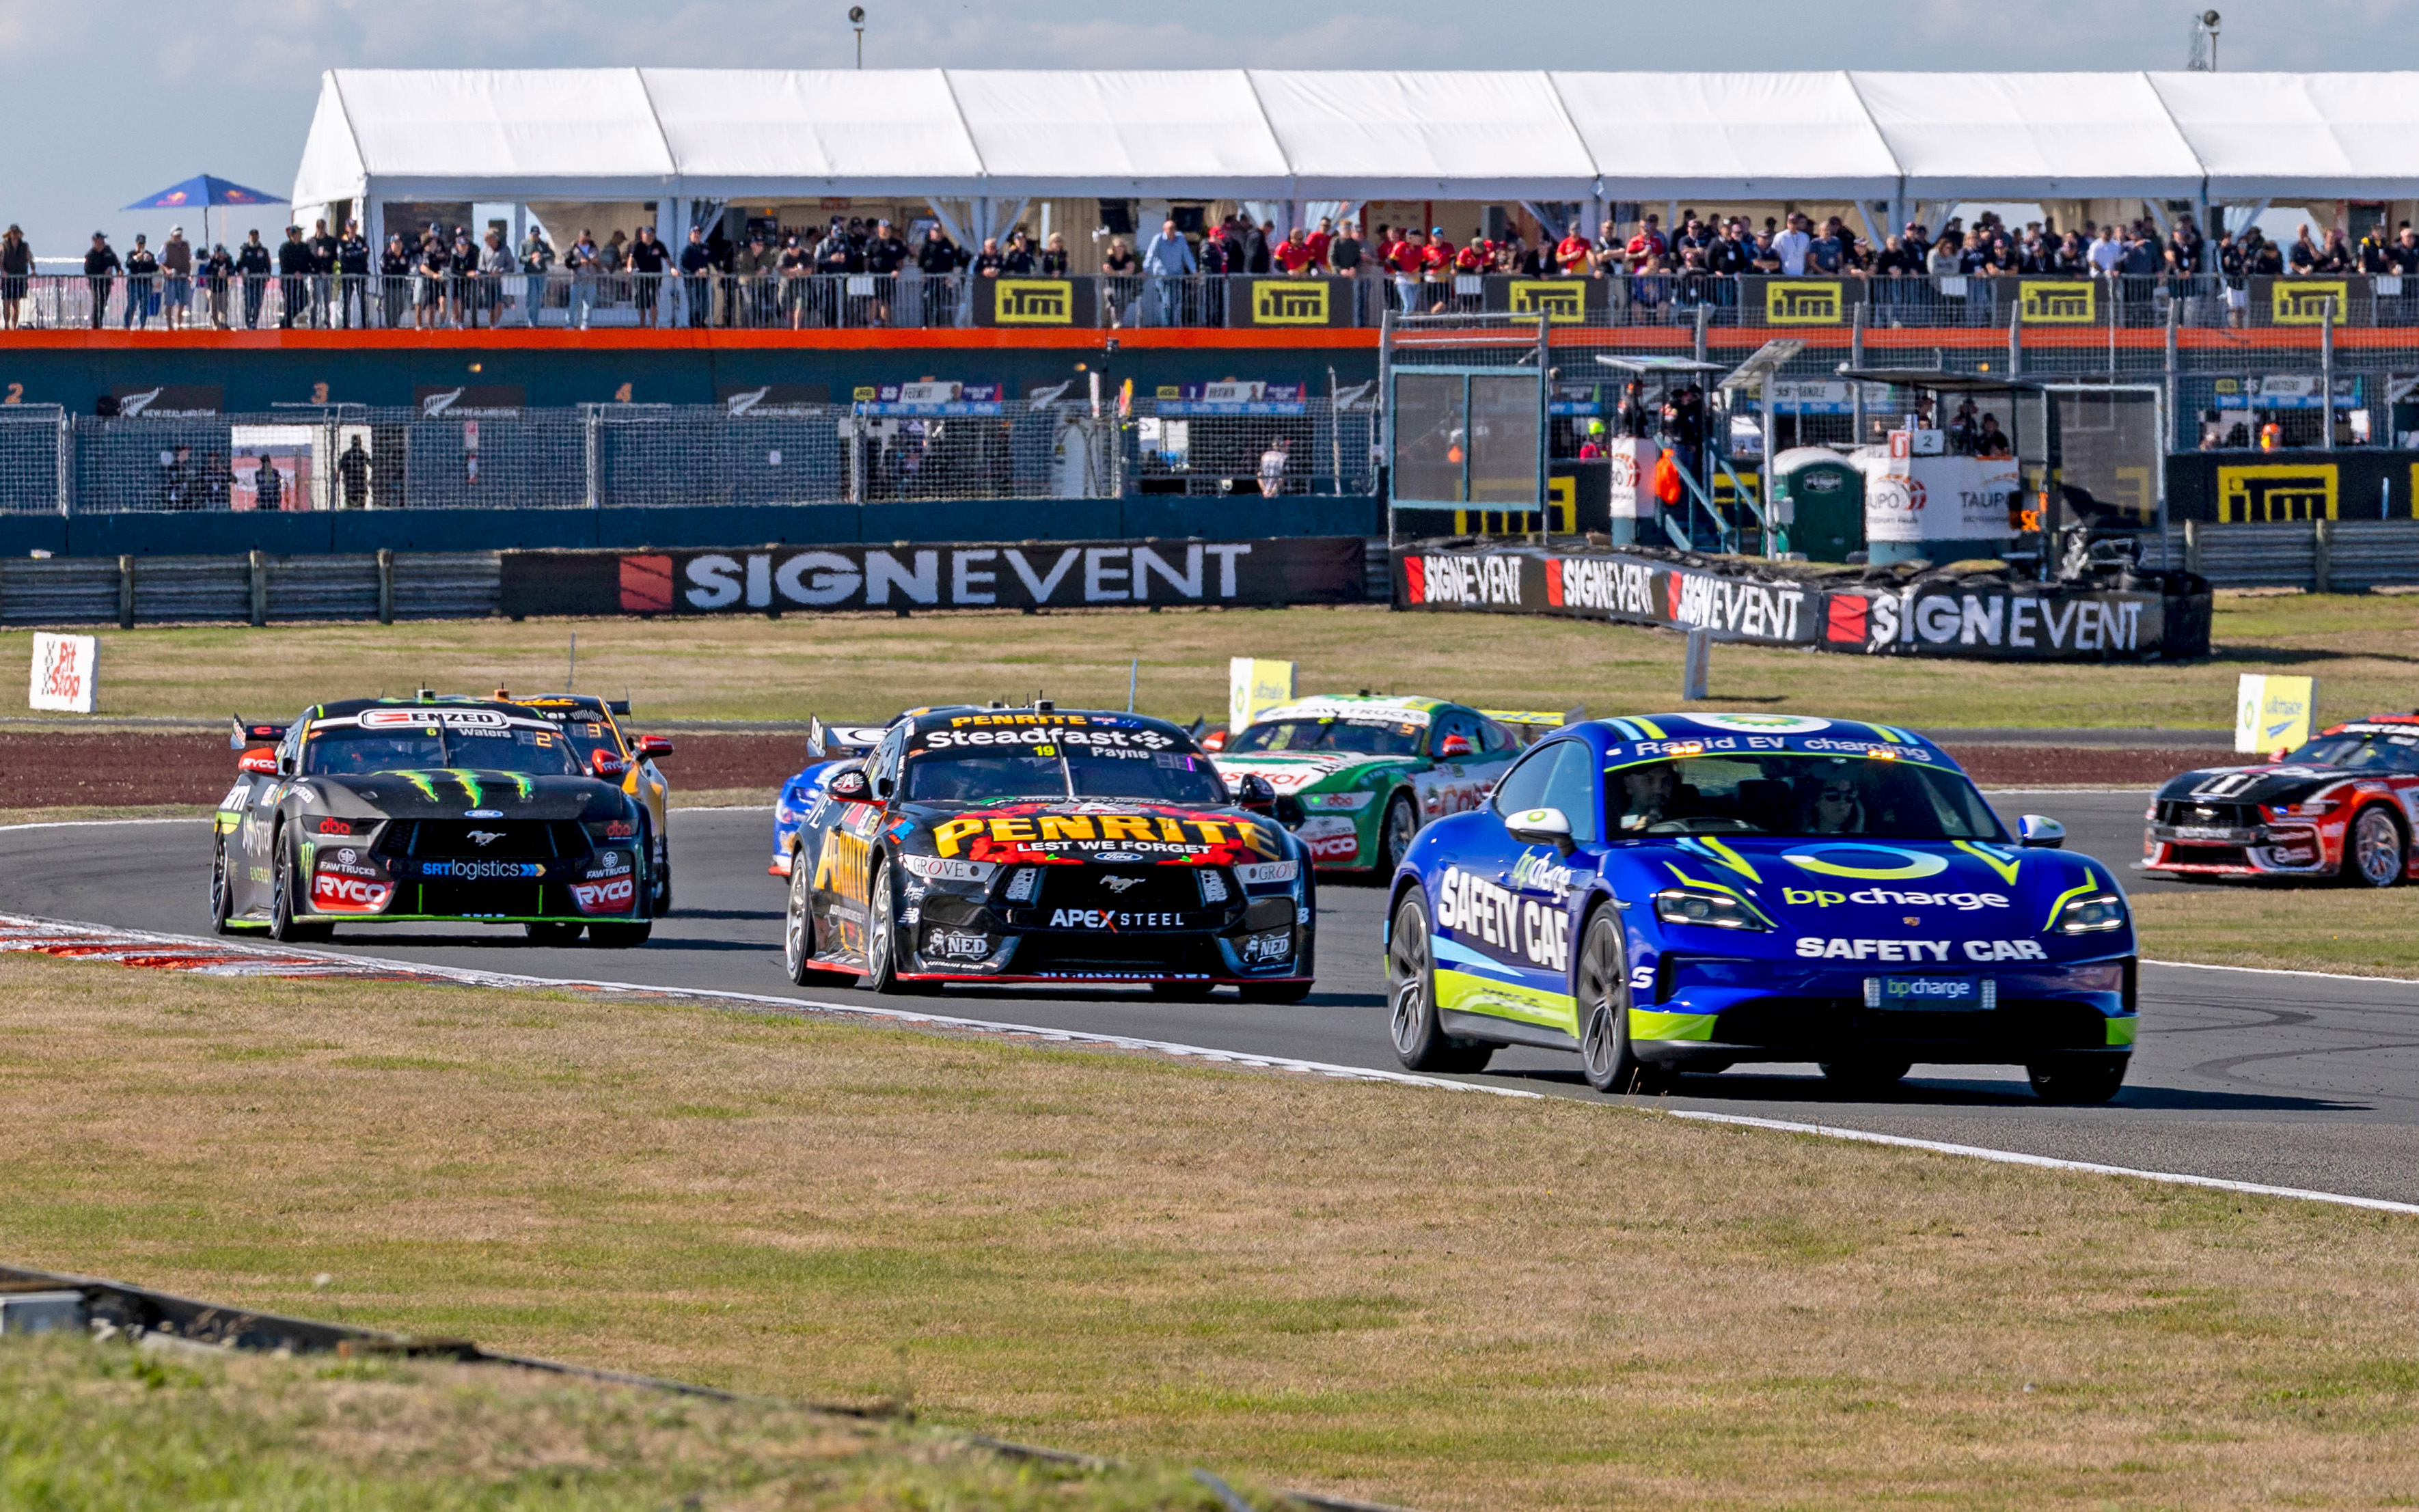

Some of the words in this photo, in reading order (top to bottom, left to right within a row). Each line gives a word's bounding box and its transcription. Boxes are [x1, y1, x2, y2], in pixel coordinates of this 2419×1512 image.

[5, 383, 24, 404] 2
[311, 383, 329, 404] 3
[615, 383, 632, 402] 4
[1923, 435, 1932, 447] 2
[1423, 555, 1522, 606] SIGNEVENT
[1562, 558, 1654, 615] SIGNEVENT
[1677, 573, 1804, 642] SIGNEVENT
[59, 641, 76, 673] Pit
[50, 665, 81, 704] Stop
[411, 713, 493, 722] ENZED
[951, 715, 1087, 728] PENRITE
[426, 728, 437, 737] 6
[459, 728, 512, 738] Waters
[536, 731, 552, 747] 2
[586, 722, 602, 738] 3
[925, 728, 1129, 749] Steadfast
[1033, 745, 1056, 757] 19
[1091, 746, 1149, 760] Payne
[1635, 737, 1736, 756] Rapid
[1746, 737, 1785, 750] EV
[1803, 738, 1932, 762] charging
[242, 758, 277, 769] RYCO
[1327, 793, 1353, 806] dba
[319, 816, 351, 834] dba
[607, 820, 631, 836] dba
[1016, 841, 1072, 853] LEST
[1078, 841, 1110, 851] WE
[1121, 841, 1212, 855] FORGET
[1104, 852, 1134, 861] Ford
[320, 861, 340, 871] FAW
[340, 864, 377, 877] TRUCKS
[586, 868, 605, 879] FAW
[604, 865, 630, 877] TRUCKS
[913, 857, 964, 877] GROVE
[315, 875, 386, 903] RYCO
[575, 879, 633, 905] RYCO
[1781, 888, 2010, 911] bpcharge
[1050, 909, 1117, 929] APEX
[1120, 913, 1184, 926] STEEL
[1438, 866, 1520, 954] SAFETY
[947, 937, 989, 954] NED
[1261, 938, 1289, 957] NED
[1796, 937, 1952, 962] SAFETY
[1963, 939, 2049, 961] CAR
[1887, 978, 1971, 999] bpcharge
